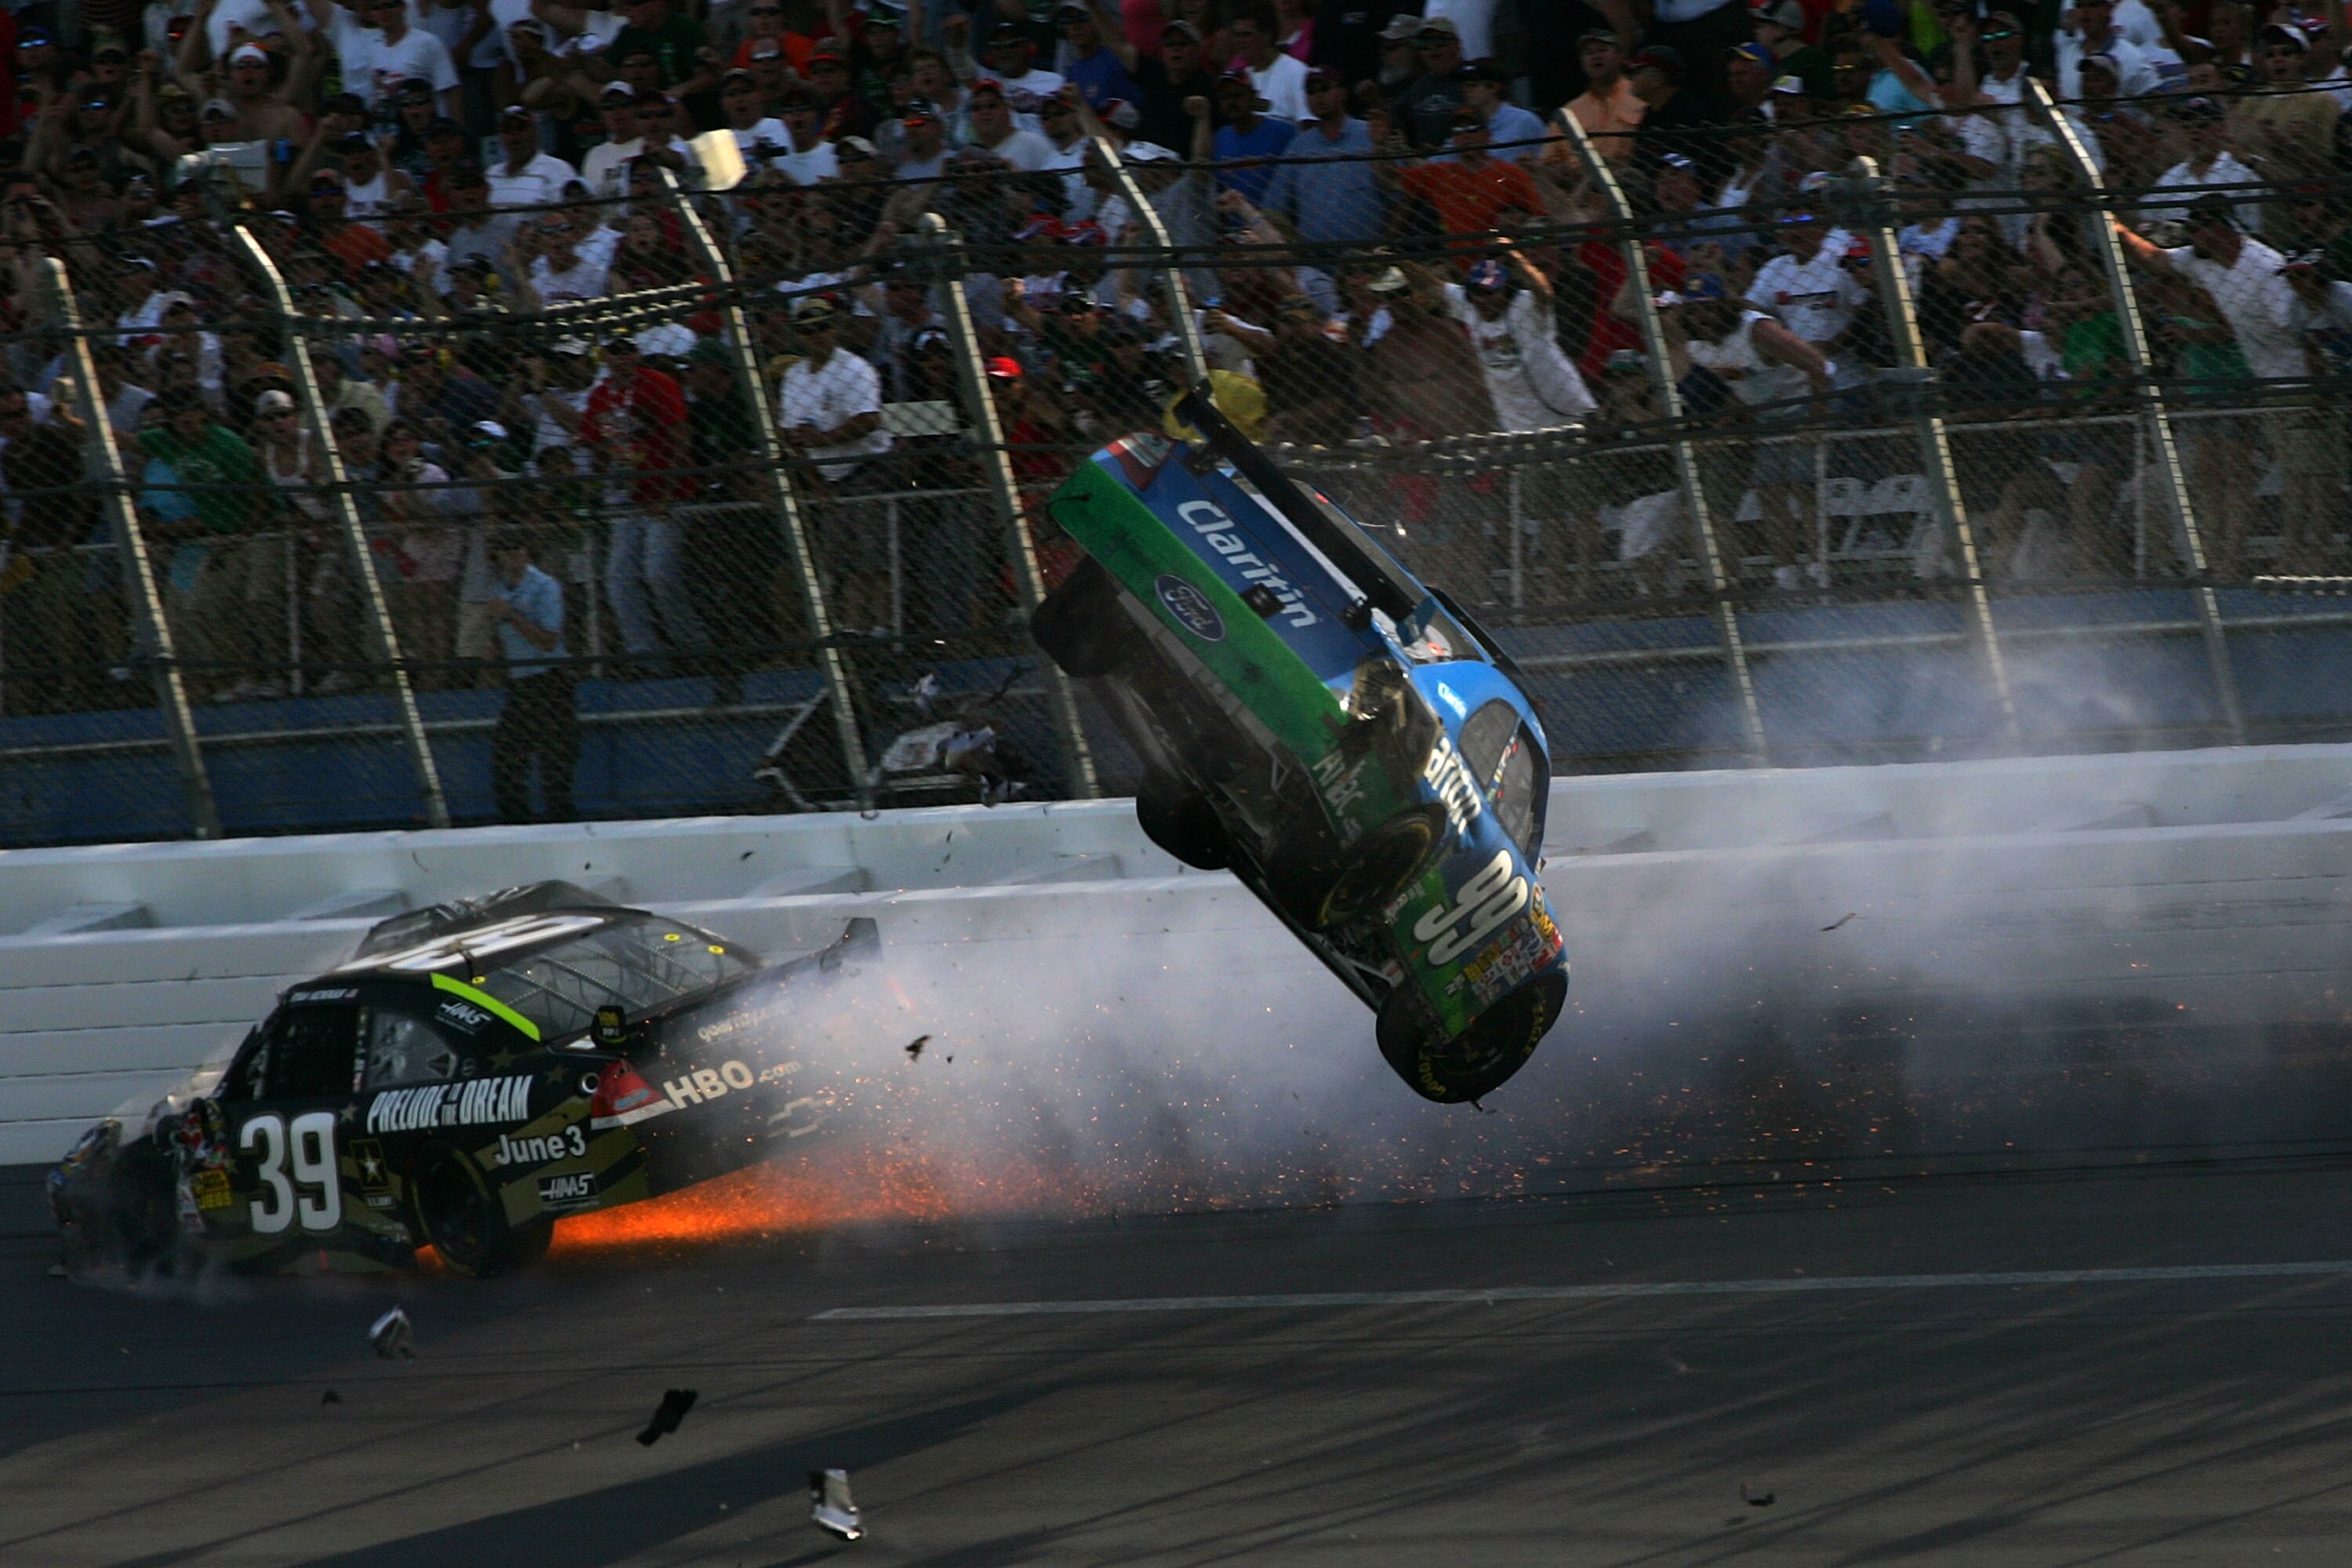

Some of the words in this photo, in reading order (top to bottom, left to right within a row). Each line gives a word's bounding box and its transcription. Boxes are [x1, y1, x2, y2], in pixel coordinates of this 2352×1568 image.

[1177, 499, 1317, 628] Claritin
[1164, 586, 1214, 630] Ford
[1414, 849, 1528, 967] 99
[366, 1083, 451, 1134] PRELUDE
[459, 1074, 534, 1125] DREAM
[239, 1112, 343, 1234] 39
[495, 1134, 565, 1165] June
[565, 1125, 586, 1157] 3
[539, 1173, 594, 1200] HAAS
